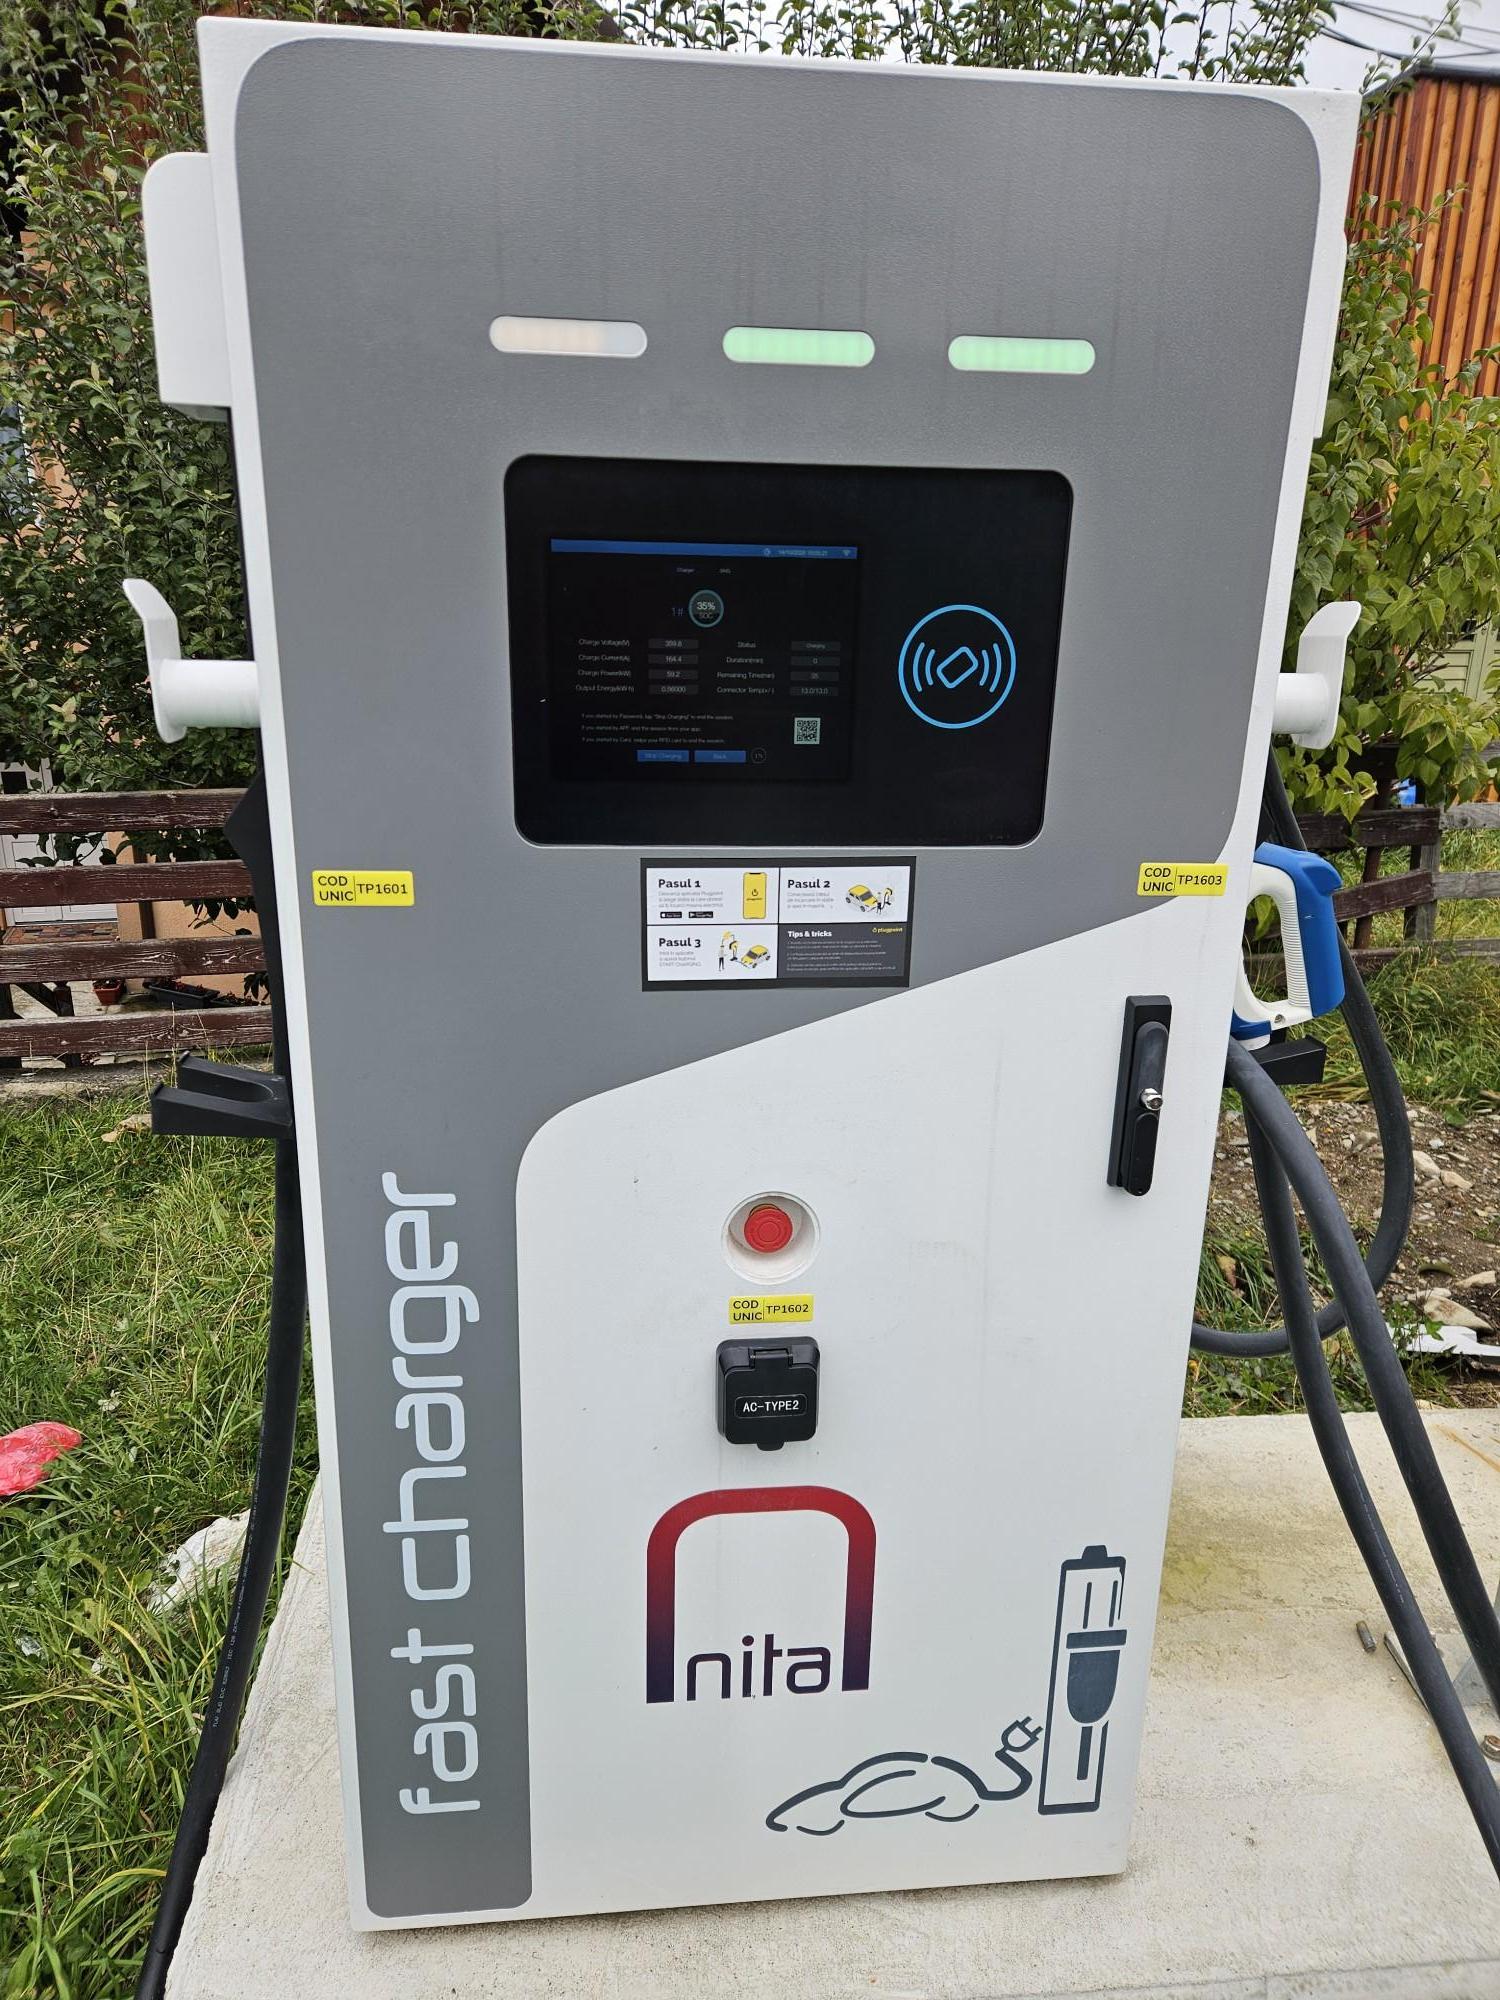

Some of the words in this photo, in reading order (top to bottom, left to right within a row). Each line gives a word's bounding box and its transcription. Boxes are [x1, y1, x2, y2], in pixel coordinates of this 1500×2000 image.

[696, 601, 716, 610] 35%
[578, 638, 600, 648] Charge
[578, 652, 600, 662] Charge
[577, 667, 599, 677] Charge
[717, 671, 747, 680] Remaining
[575, 683, 596, 692] Output
[717, 686, 747, 694] Connector
[1144, 868, 1171, 878] COD
[318, 875, 348, 886] COD
[658, 878, 691, 888] Pasul
[694, 880, 701, 888] 1
[787, 878, 820, 888] Pasul
[823, 880, 831, 888] 2
[1178, 875, 1222, 886] TP1603
[356, 884, 408, 894] TP1601
[1143, 882, 1174, 892] UNIC
[319, 891, 354, 901] UNIC
[787, 930, 804, 939] Tips
[804, 930, 810, 938] &
[811, 930, 832, 938] tricks
[658, 937, 692, 947] Pasul
[694, 939, 701, 948] 3
[733, 1299, 759, 1310] COD
[766, 1304, 809, 1315] TP1602
[733, 1312, 764, 1322] UNIC
[382, 1172, 480, 1600] charger
[742, 1399, 799, 1412] AC-TYPE2
[687, 1634, 831, 1701] nita
[391, 1629, 480, 1813] fast
